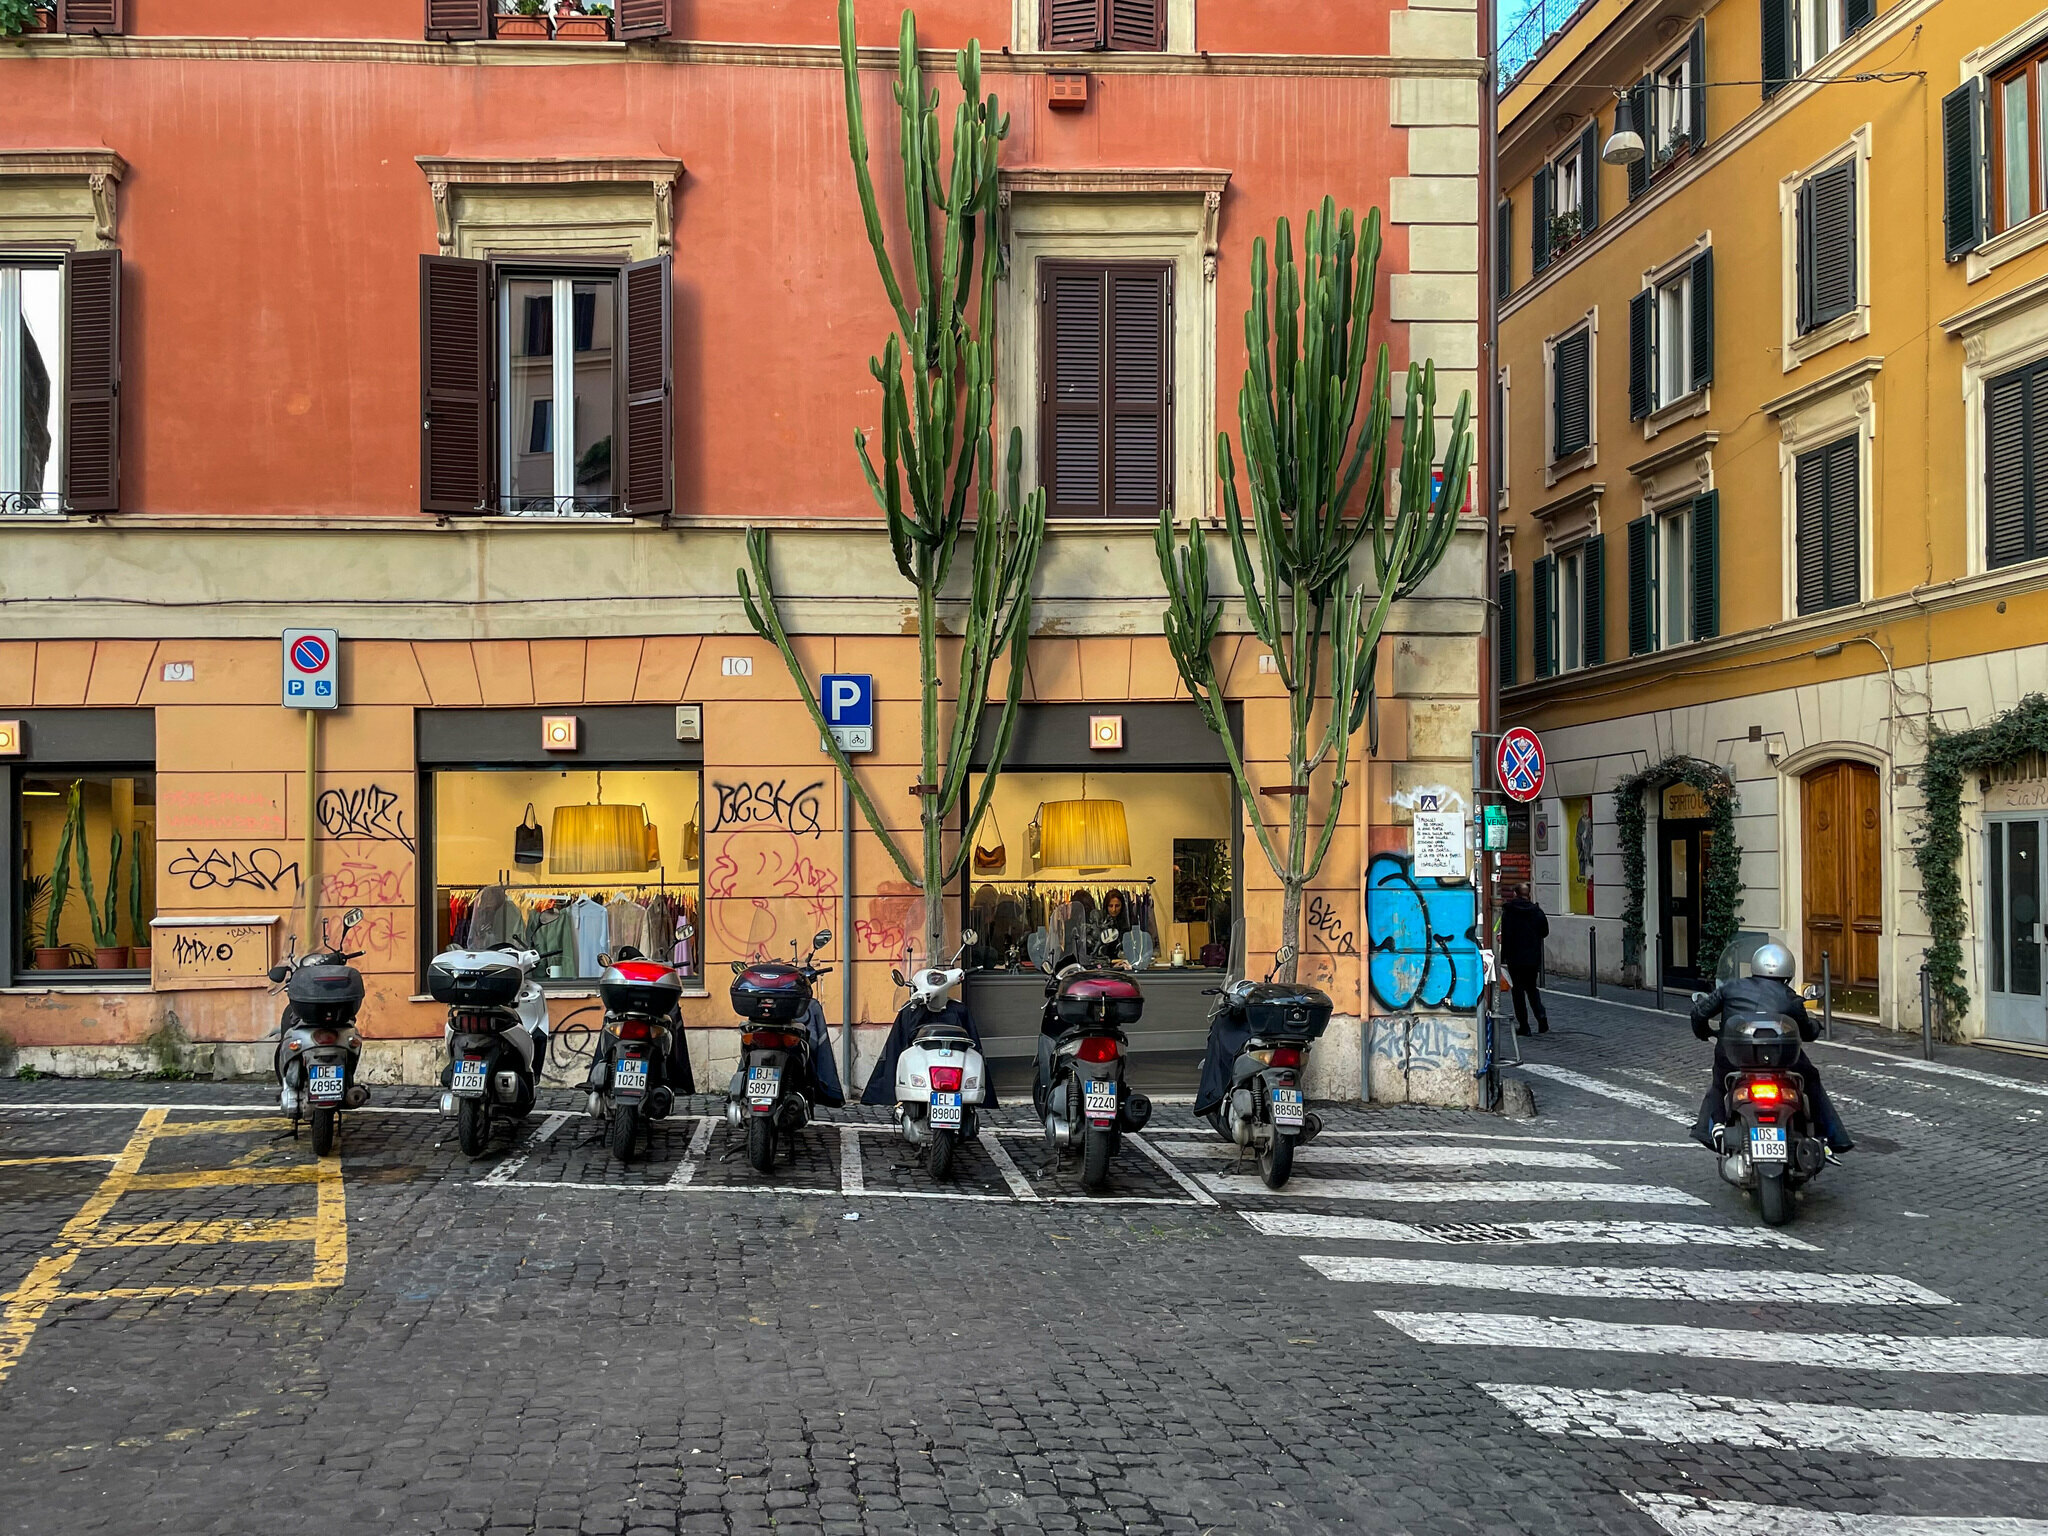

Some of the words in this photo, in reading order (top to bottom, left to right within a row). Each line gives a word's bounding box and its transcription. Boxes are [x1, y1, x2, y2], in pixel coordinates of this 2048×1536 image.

[171, 663, 185, 679] 9
[728, 658, 748, 675] 10
[291, 682, 301, 694] P
[831, 680, 861, 721] P
[1669, 793, 1696, 811] SPIRITO
[311, 1080, 342, 1092] 48963
[454, 1075, 482, 1087] 01261
[618, 1074, 645, 1087] 10216
[749, 1082, 776, 1094] 58971
[1087, 1096, 1114, 1108] 72240
[932, 1107, 960, 1120] 89800
[1275, 1104, 1302, 1116] 88506
[1754, 1143, 1785, 1155] 11839
